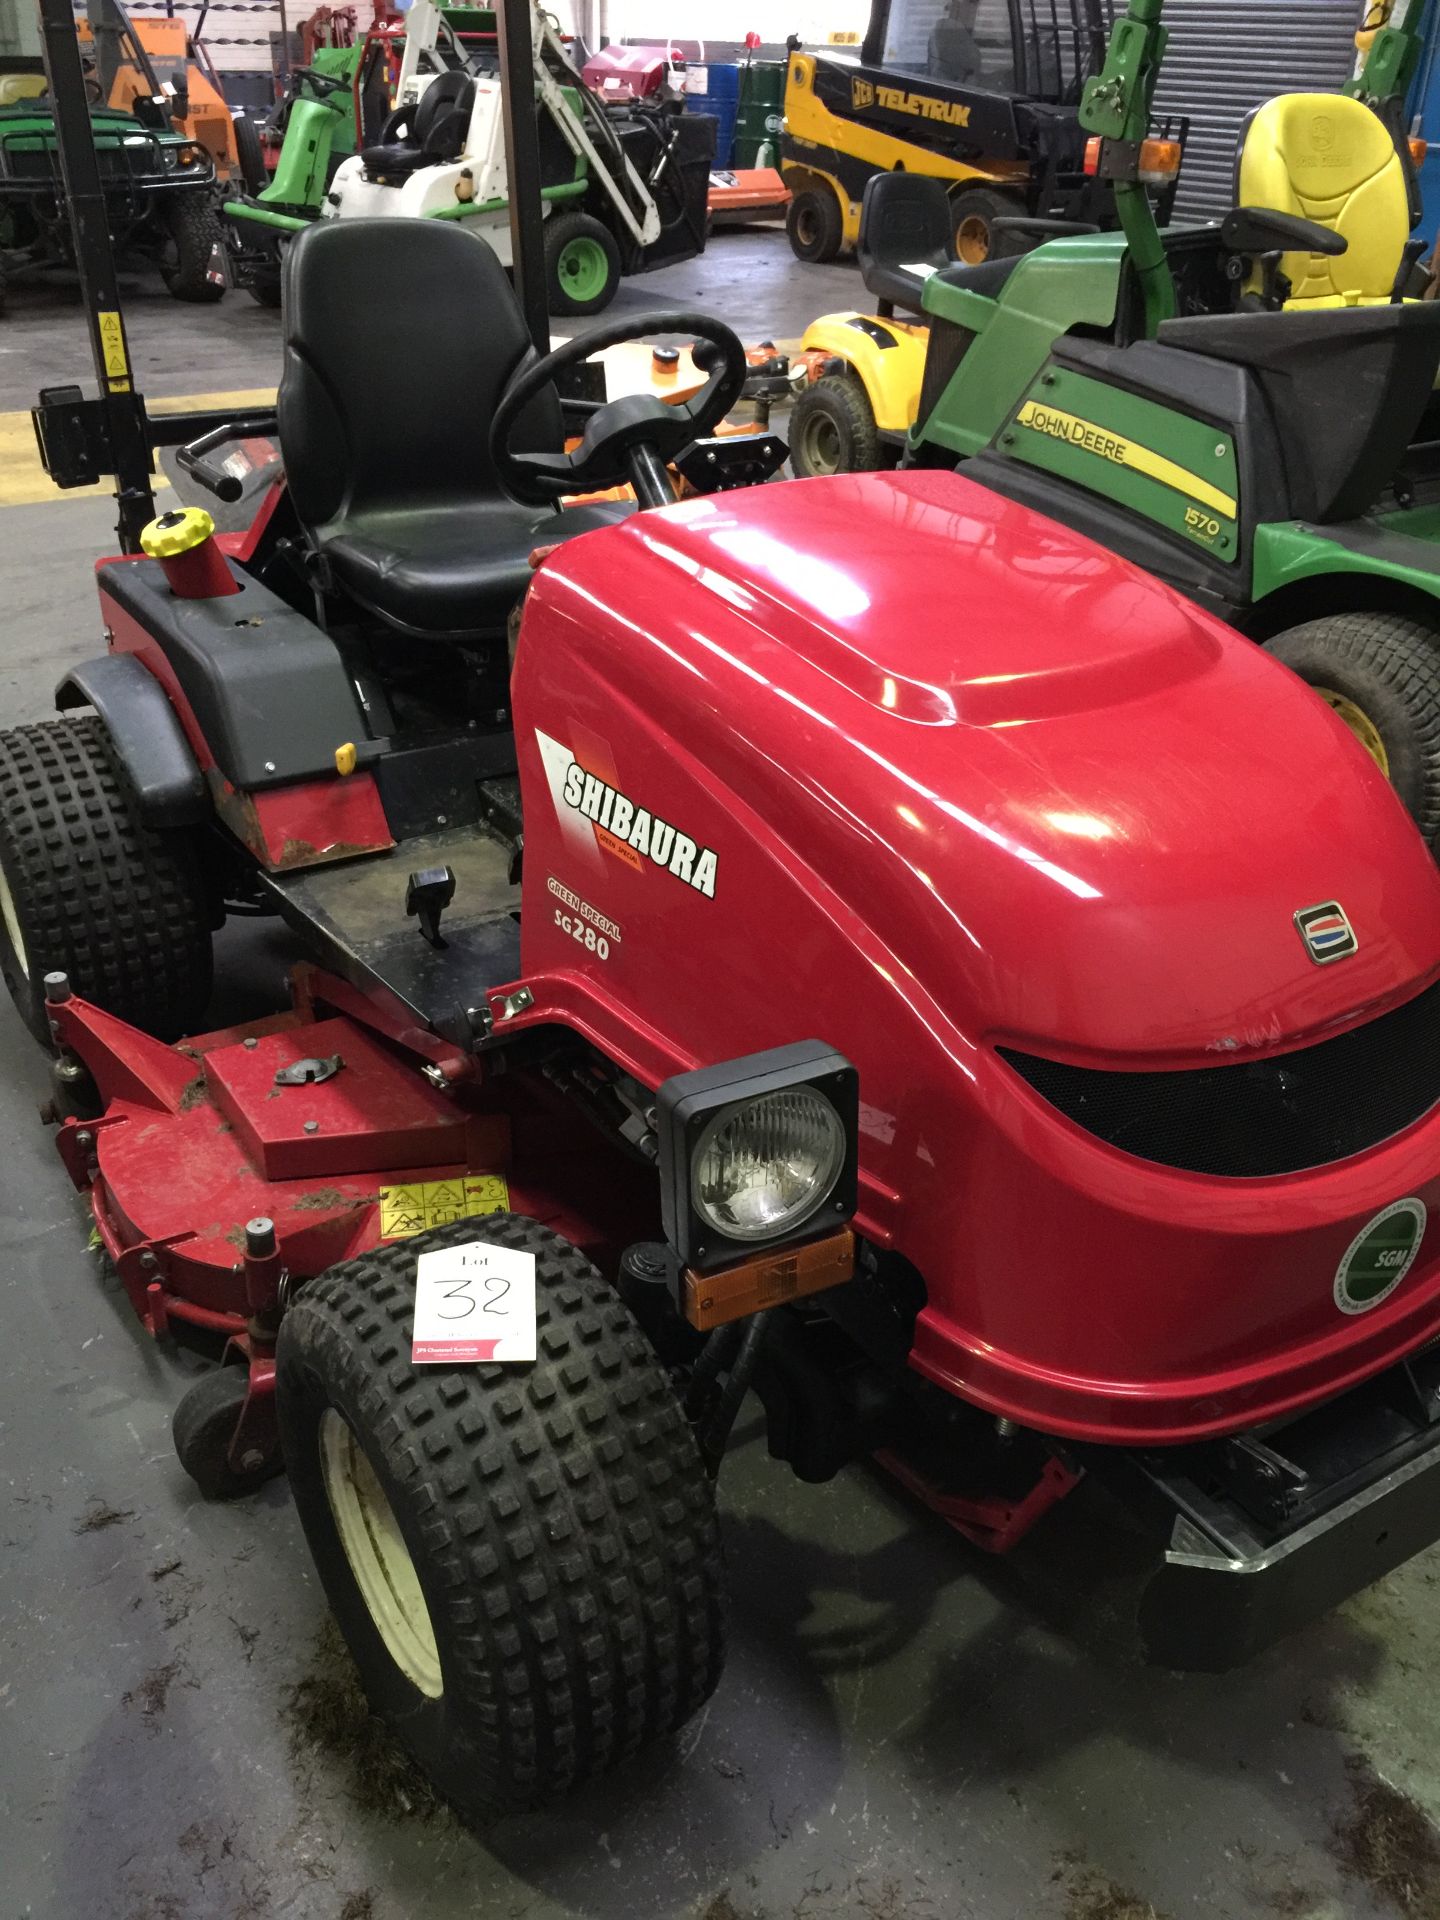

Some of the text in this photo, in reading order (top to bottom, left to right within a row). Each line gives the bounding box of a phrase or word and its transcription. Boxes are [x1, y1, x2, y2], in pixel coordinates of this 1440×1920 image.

[853, 78, 971, 127] JCB TELETRUK
[1025, 407, 1127, 461] JOHN DEERE
[1184, 507, 1219, 535] 1570
[563, 762, 719, 901] SHIBAURA
[547, 878, 621, 942] GREEN SPECIAL
[554, 909, 609, 960] SG280
[462, 1256, 489, 1266] Lot
[1374, 1249, 1408, 1268] SGM
[433, 1277, 511, 1319] 32
